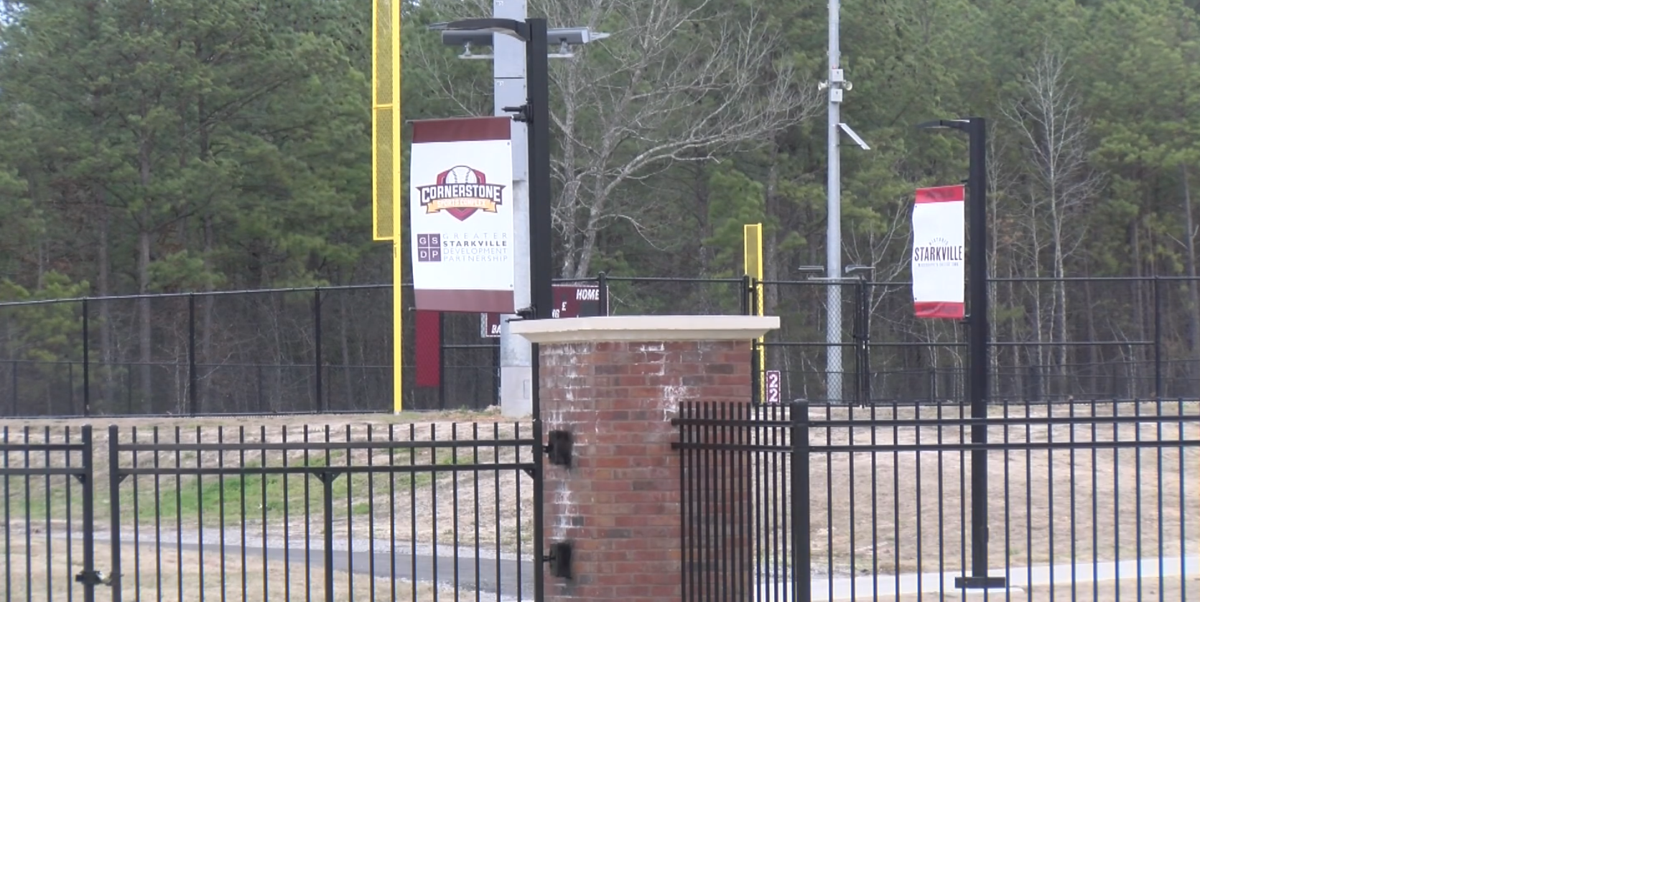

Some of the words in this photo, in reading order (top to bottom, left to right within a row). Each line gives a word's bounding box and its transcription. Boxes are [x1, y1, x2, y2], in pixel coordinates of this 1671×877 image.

[421, 184, 501, 203] CORNERSTONE
[914, 245, 963, 262] STARKVILLE
[575, 288, 600, 301] HOME
